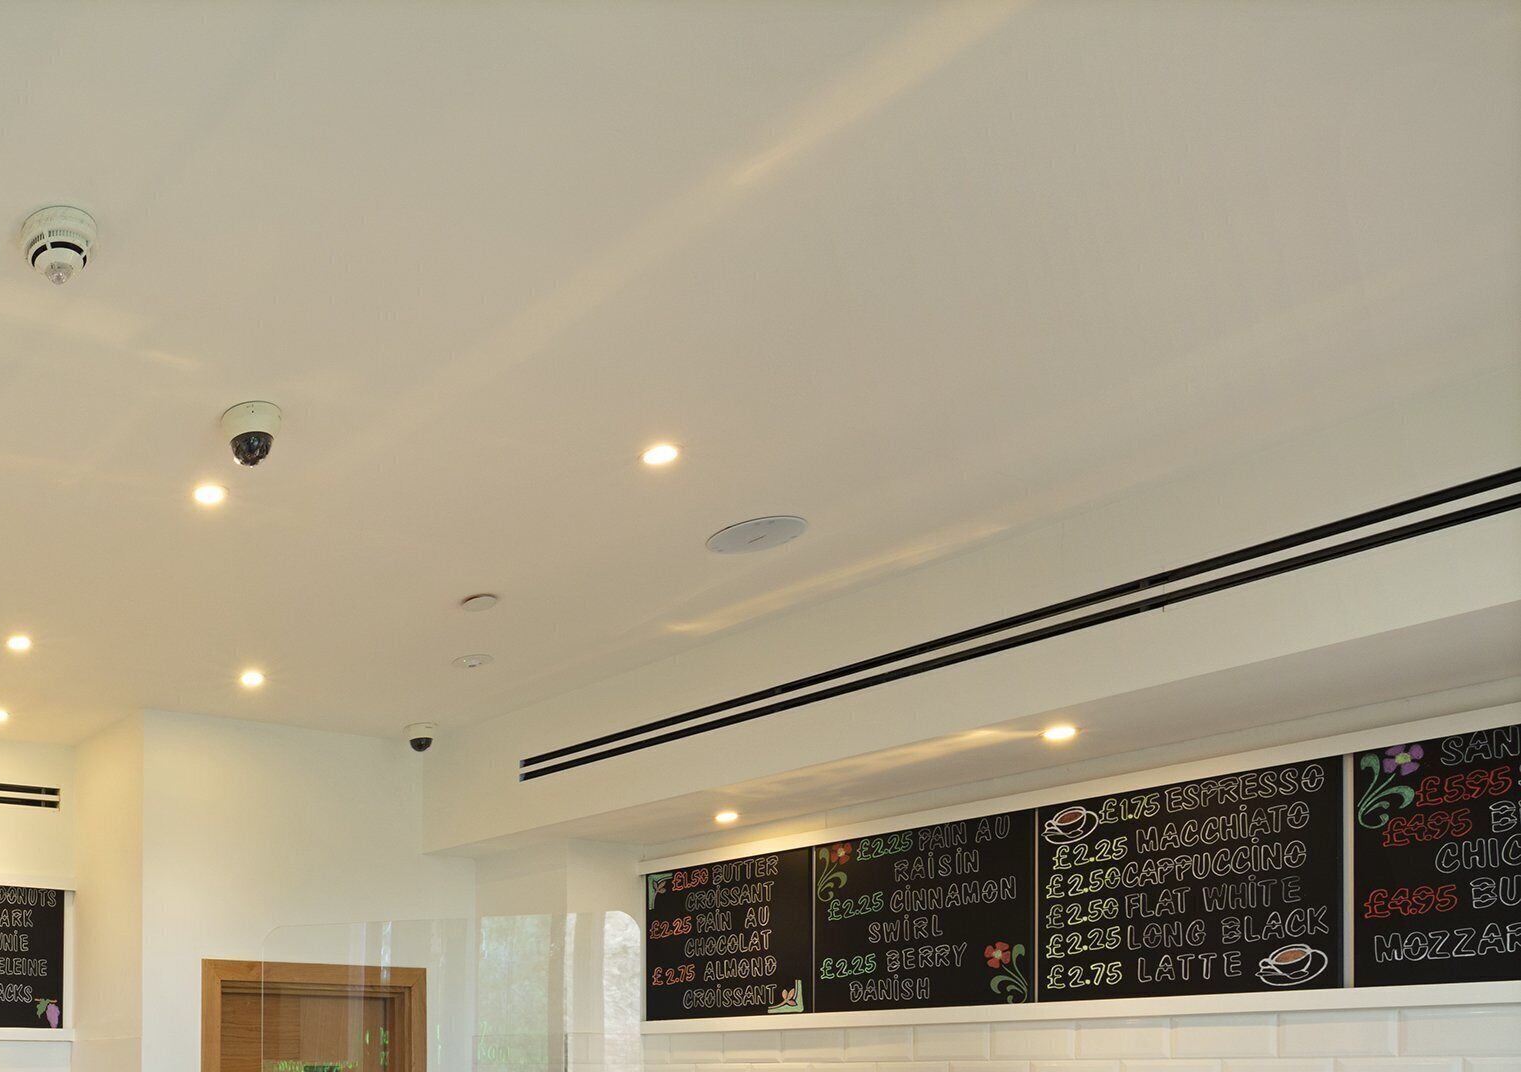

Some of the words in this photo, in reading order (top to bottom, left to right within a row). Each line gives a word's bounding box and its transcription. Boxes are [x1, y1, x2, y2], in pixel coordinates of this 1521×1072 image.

[1099, 792, 1161, 825] £1.75
[1165, 764, 1325, 813] ESPRESSO
[1416, 765, 1512, 807] £5.95
[857, 831, 913, 862] £2.25
[918, 821, 967, 851] PAIN
[975, 815, 1010, 843] AU
[1052, 836, 1128, 870] £2.25
[1135, 801, 1310, 853] MACCHIATO
[1383, 808, 1473, 847] £4.95
[671, 868, 708, 891] £1.50
[712, 855, 779, 885] BUTTER
[894, 847, 979, 882] RAISIN
[1046, 867, 1121, 899] £2.50
[1121, 837, 1307, 887] CAPPUCCINO
[685, 881, 774, 911] CROISSANT
[828, 891, 884, 921] £2.25
[890, 875, 1017, 913] CINNAMON
[1046, 898, 1119, 929] £2.50
[1125, 886, 1191, 918] FLAT
[1202, 874, 1302, 912] WHITE
[1364, 884, 1458, 919] £4.95
[650, 916, 692, 939] £2.25
[696, 909, 732, 933] PAIN
[745, 906, 770, 928] AU
[869, 914, 943, 943] SWIRL
[1046, 926, 1121, 958] £2.25
[1127, 919, 1206, 950] LONG
[1221, 905, 1329, 944] BLACK
[684, 929, 771, 958] CHOCOLAT
[820, 953, 876, 980] £2.25
[886, 942, 967, 972] BERRY
[703, 955, 777, 981] ALMOND
[1047, 961, 1123, 989] £2.75
[1137, 951, 1242, 982] LATTE
[683, 984, 777, 1009] CROISSANT
[849, 974, 930, 1002] DANISH
